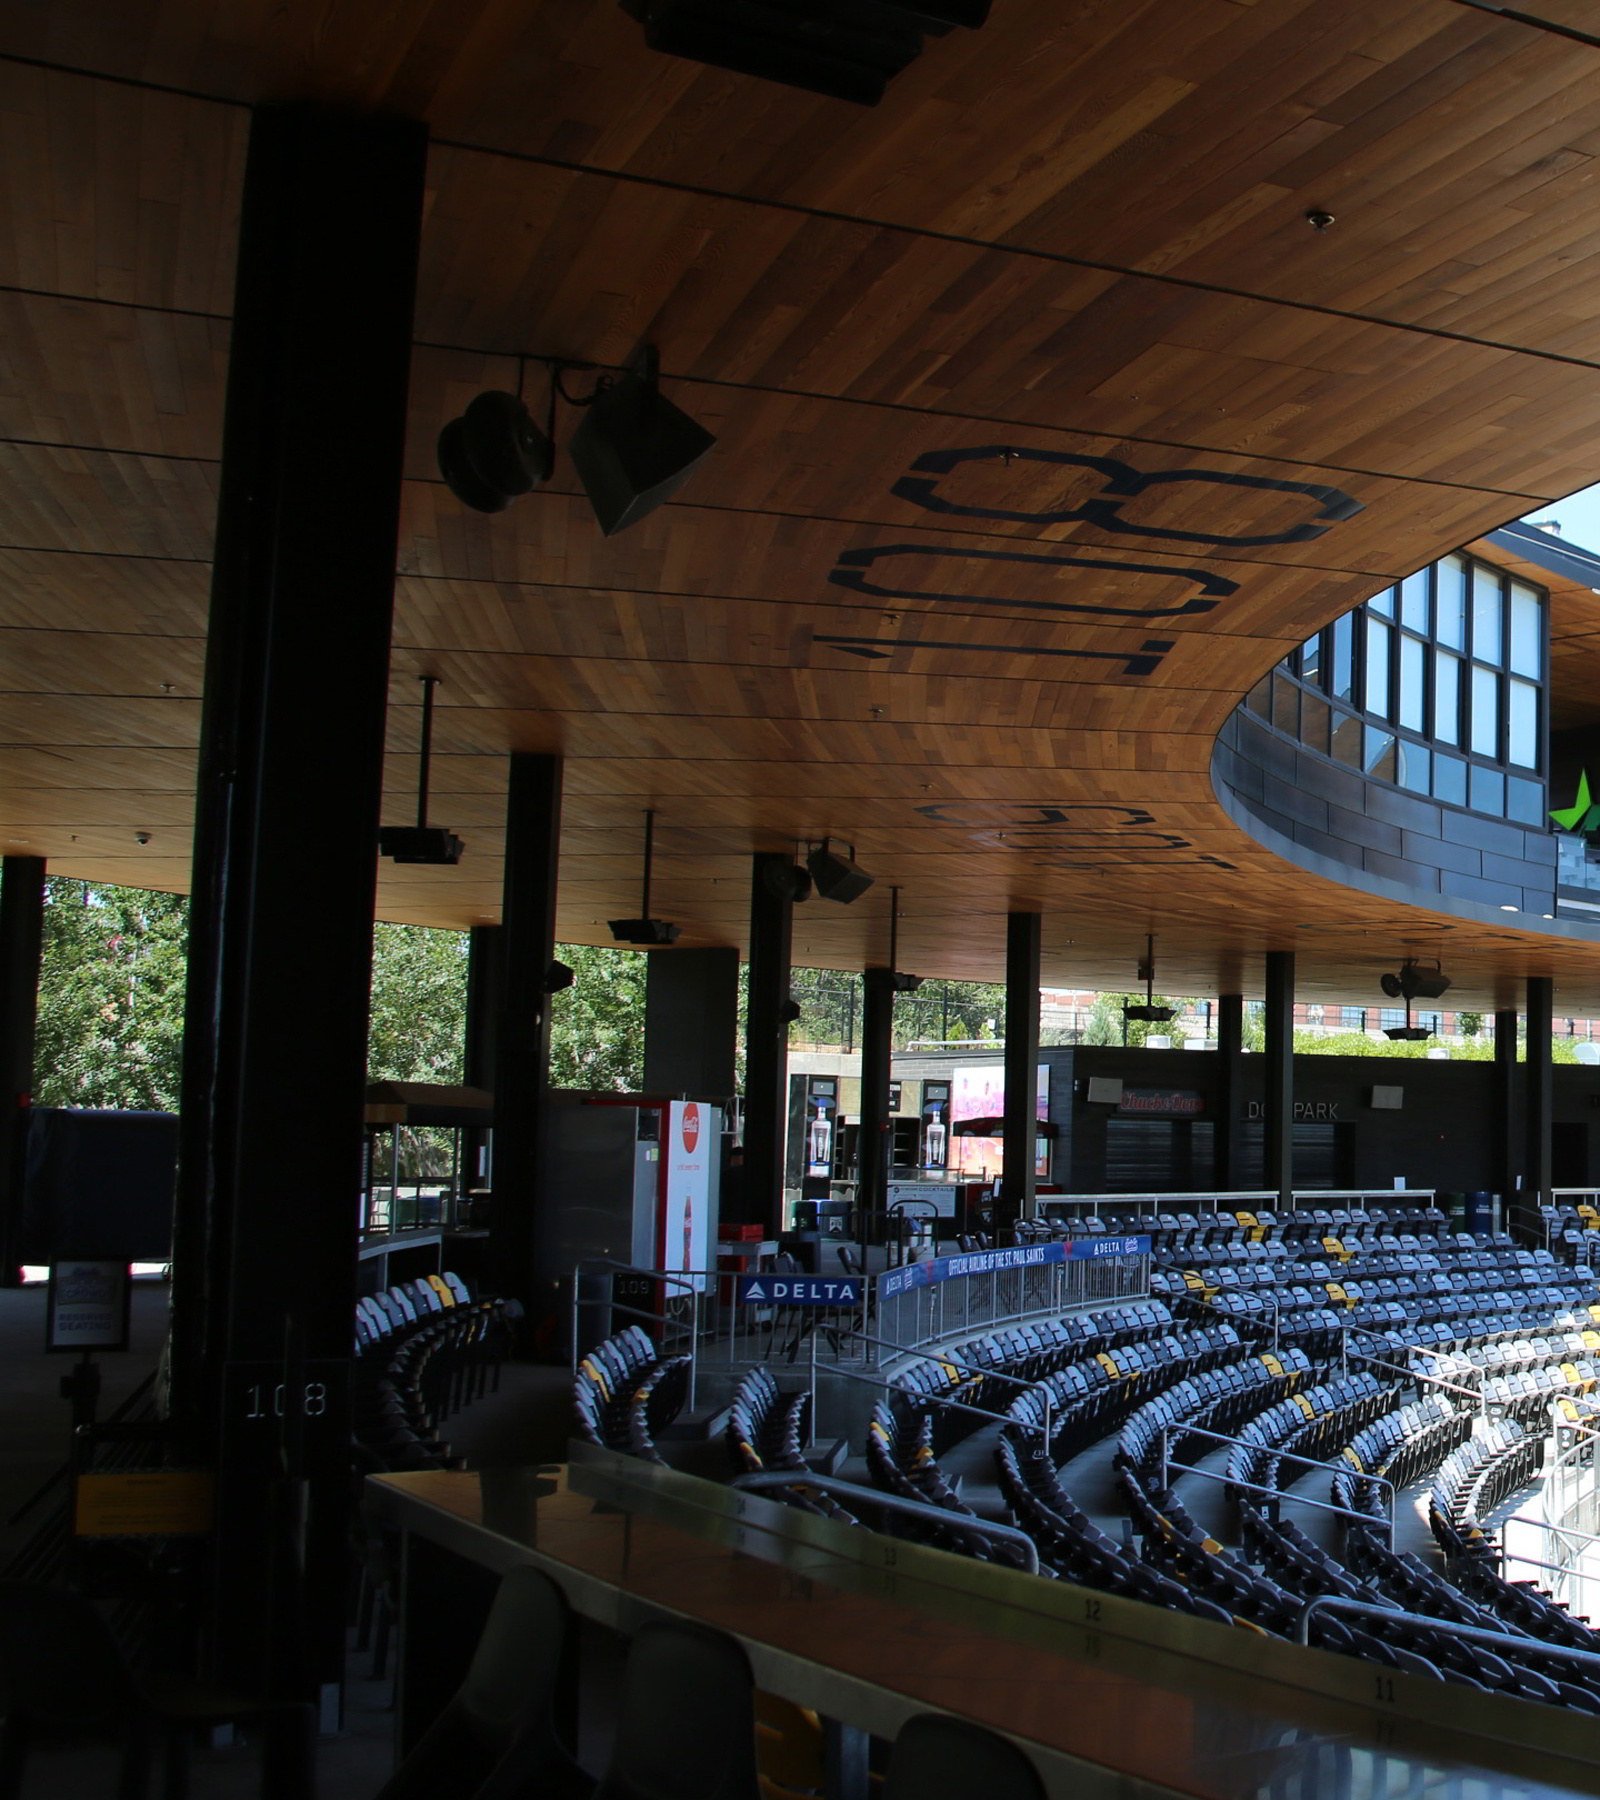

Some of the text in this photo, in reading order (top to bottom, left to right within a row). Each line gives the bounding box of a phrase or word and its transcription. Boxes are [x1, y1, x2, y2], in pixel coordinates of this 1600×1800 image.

[813, 445, 1366, 676] 108
[1293, 1102, 1338, 1119] PARK
[1100, 1241, 1120, 1254] DELTA
[948, 1258, 968, 1276] OFFICIAL
[969, 1255, 987, 1272] AIRLINE
[988, 1253, 995, 1269] OF
[995, 1252, 1004, 1268] THE
[1013, 1249, 1026, 1266] PAUL
[1026, 1247, 1044, 1263] SAINTS
[619, 1280, 649, 1295] 109
[773, 1282, 854, 1300] DELTA
[889, 1275, 902, 1292] DELTA
[59, 1322, 112, 1331] SEATING
[884, 1547, 897, 1566] 13
[1085, 1598, 1101, 1622] 12
[1375, 1676, 1395, 1703] 11
